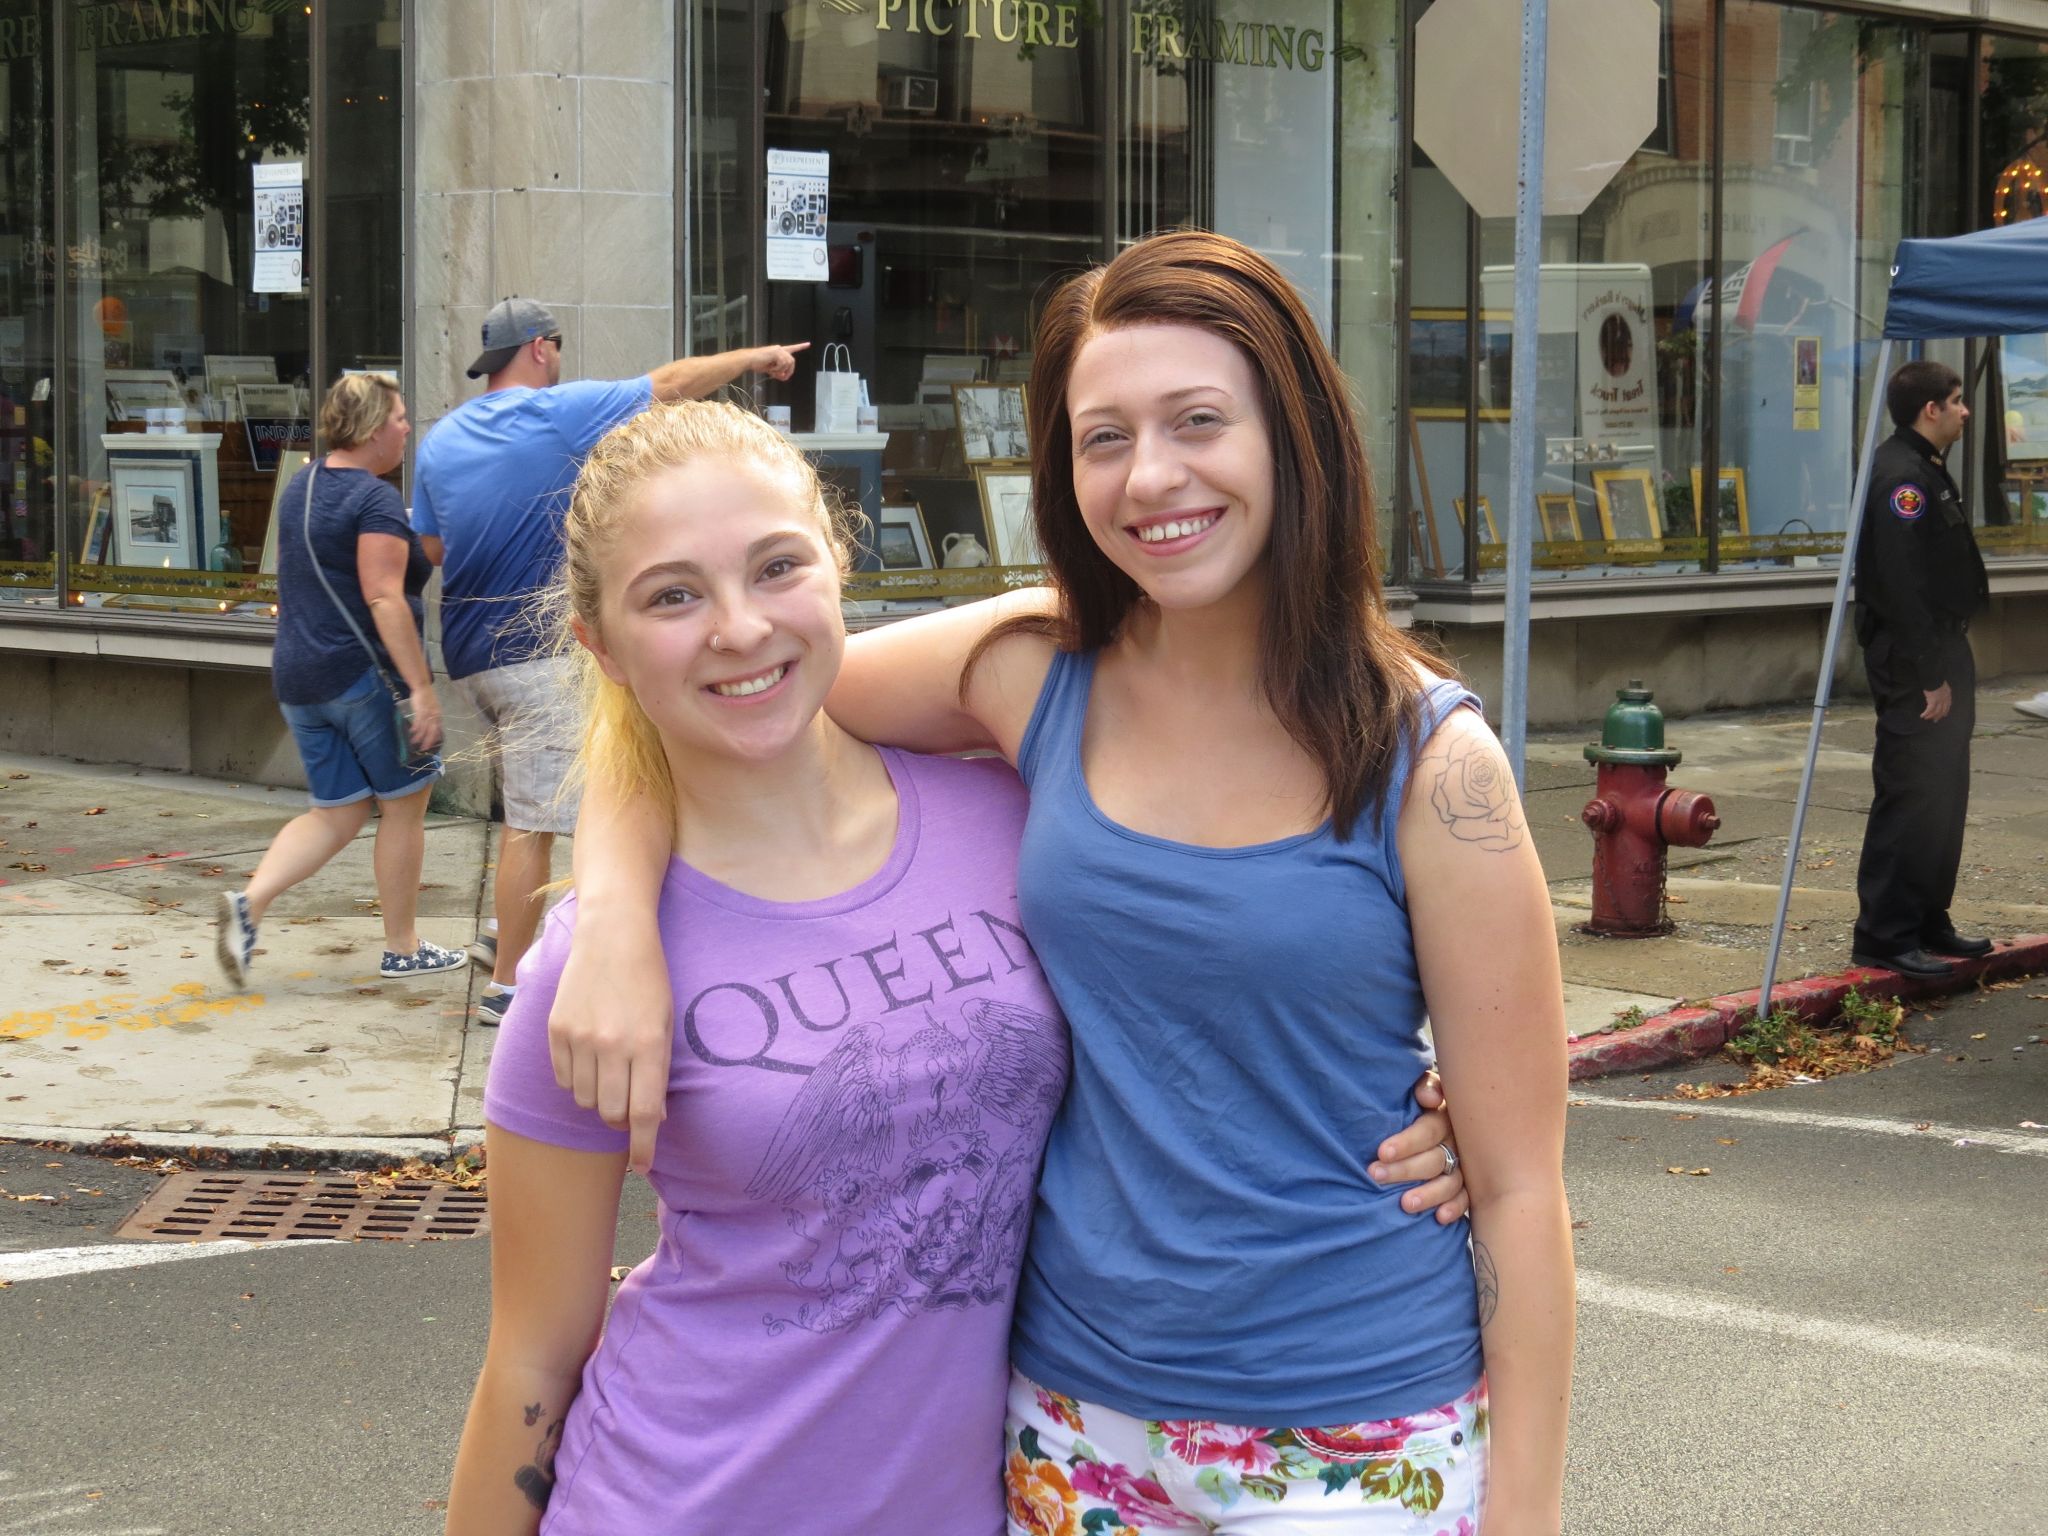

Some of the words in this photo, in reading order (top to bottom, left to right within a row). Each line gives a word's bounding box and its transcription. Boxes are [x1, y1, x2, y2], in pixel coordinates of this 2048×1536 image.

[77, 0, 257, 51] FRAMING
[875, 0, 1079, 48] PICTURE
[1131, 11, 1325, 72] FRAMING
[683, 908, 1028, 1076] QUEEN
